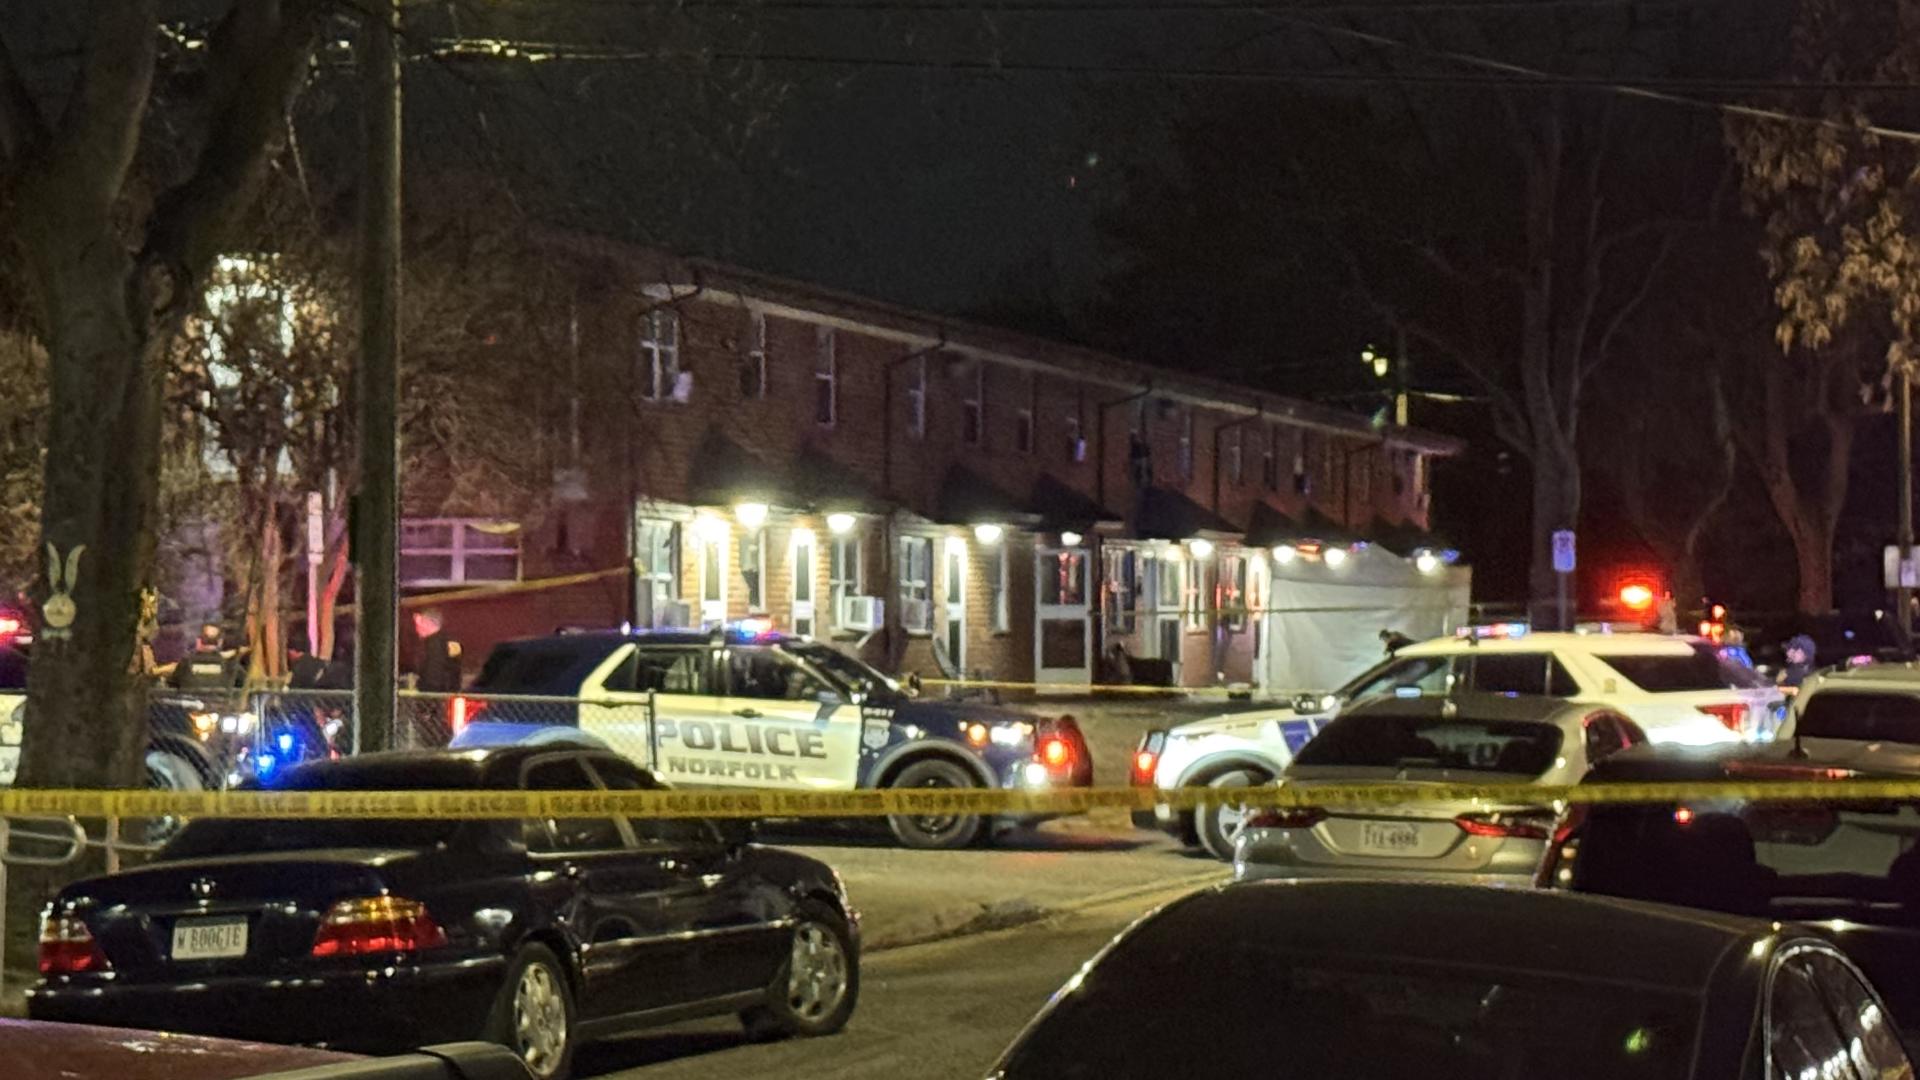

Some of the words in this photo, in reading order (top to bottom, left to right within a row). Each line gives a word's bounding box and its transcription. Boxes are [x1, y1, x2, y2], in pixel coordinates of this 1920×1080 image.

[656, 718, 827, 759] POLICE
[668, 756, 798, 781] NORFOLK
[190, 925, 241, 950] BOOGIE
